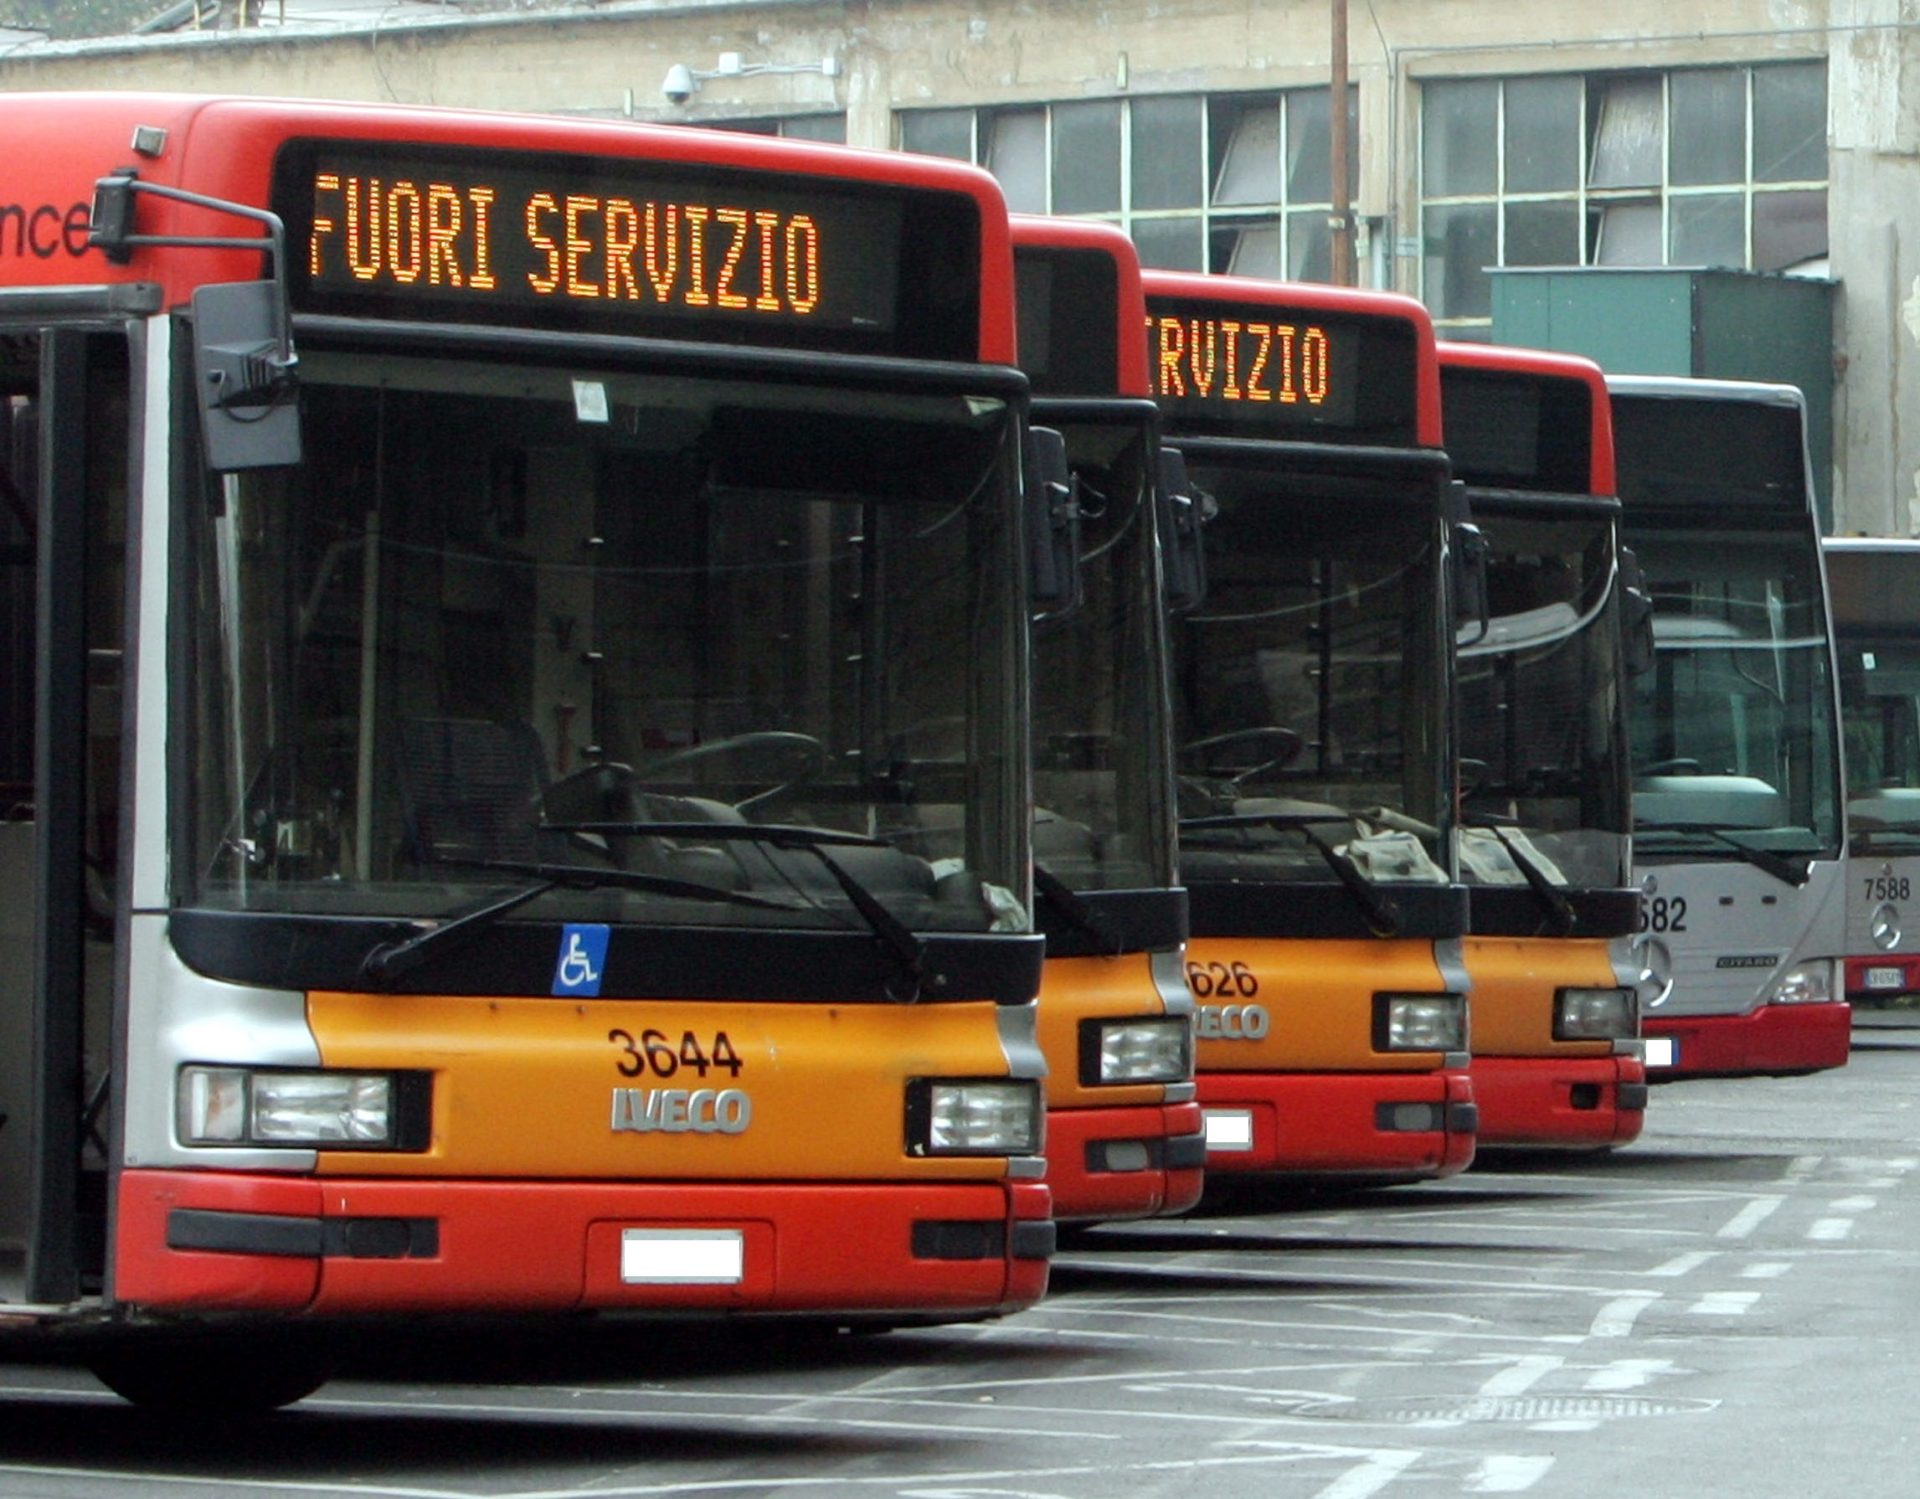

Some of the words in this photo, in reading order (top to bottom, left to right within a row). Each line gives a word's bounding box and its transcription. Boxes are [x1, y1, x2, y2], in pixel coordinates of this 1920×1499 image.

[310, 172, 496, 289] FUORI
[527, 192, 820, 313] SERVIZIO
[1144, 316, 1328, 404] RVIZIO
[1864, 878, 1911, 900] 7588
[608, 1028, 744, 1078] 3644
[611, 1087, 751, 1134] IVECO
